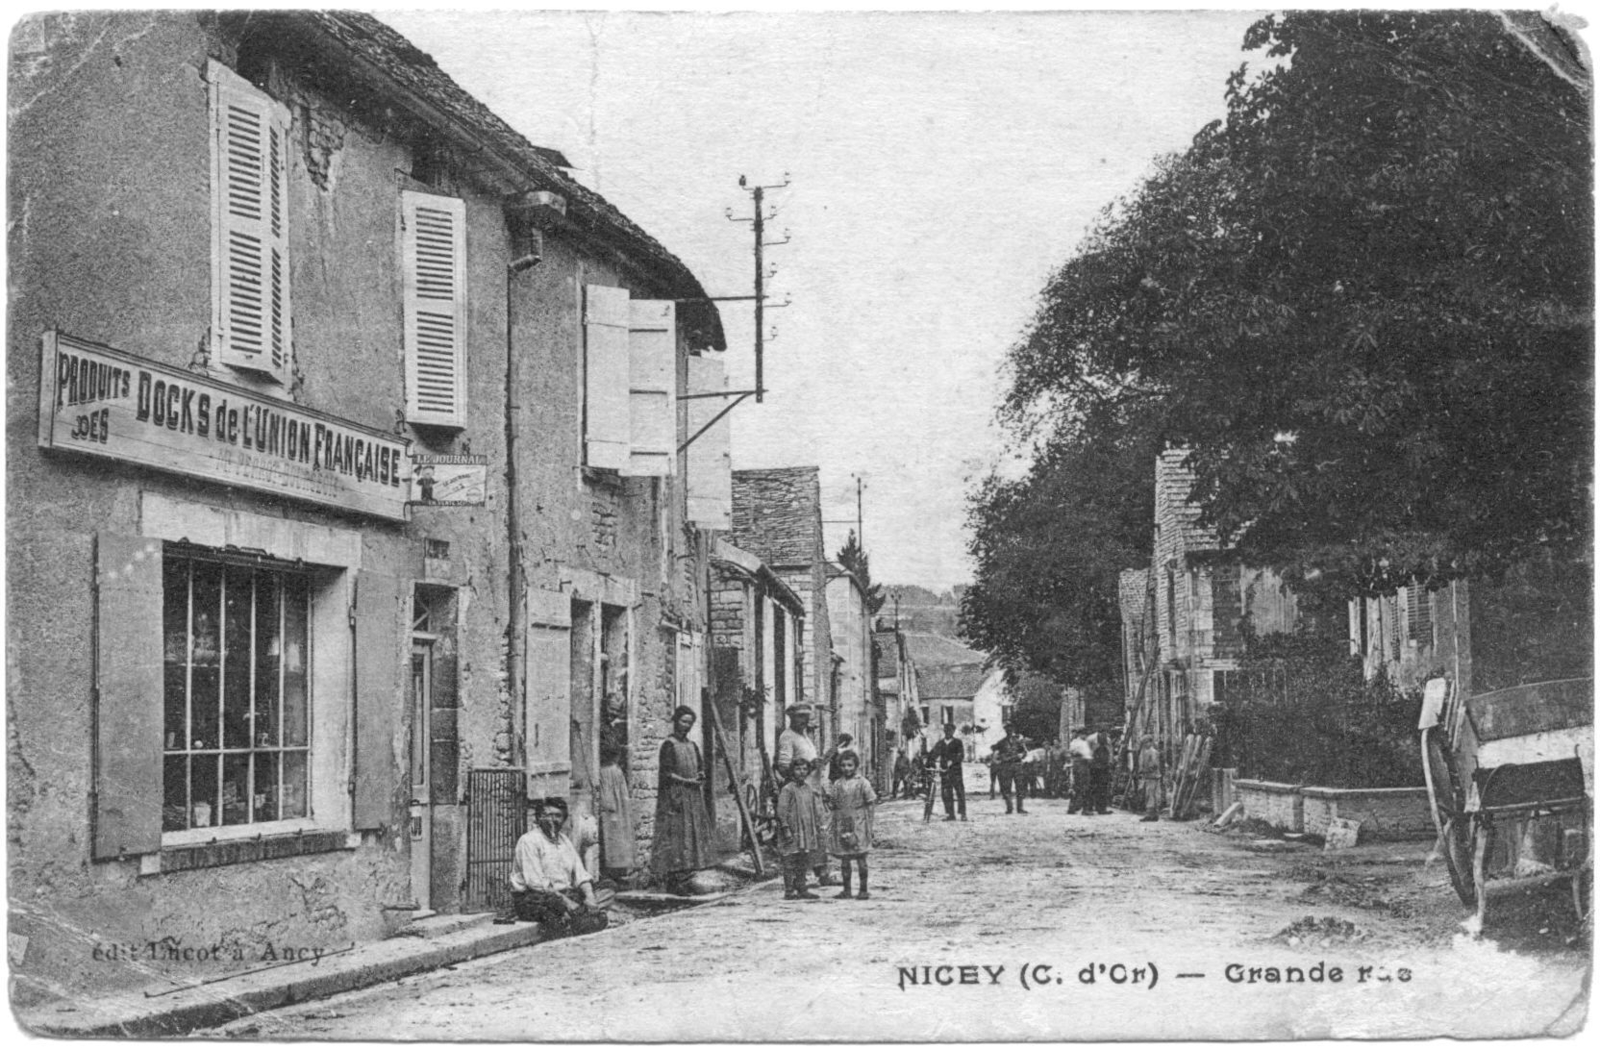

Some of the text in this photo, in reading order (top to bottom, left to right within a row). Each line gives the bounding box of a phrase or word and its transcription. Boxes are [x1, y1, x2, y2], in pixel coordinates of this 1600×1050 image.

[57, 351, 130, 413] PRODUITS
[136, 370, 210, 438] DOCKS
[216, 399, 238, 445] de
[242, 400, 310, 464] L'UNION
[313, 423, 400, 488] FRANÇAISE
[417, 454, 482, 464] LE JOURNAL
